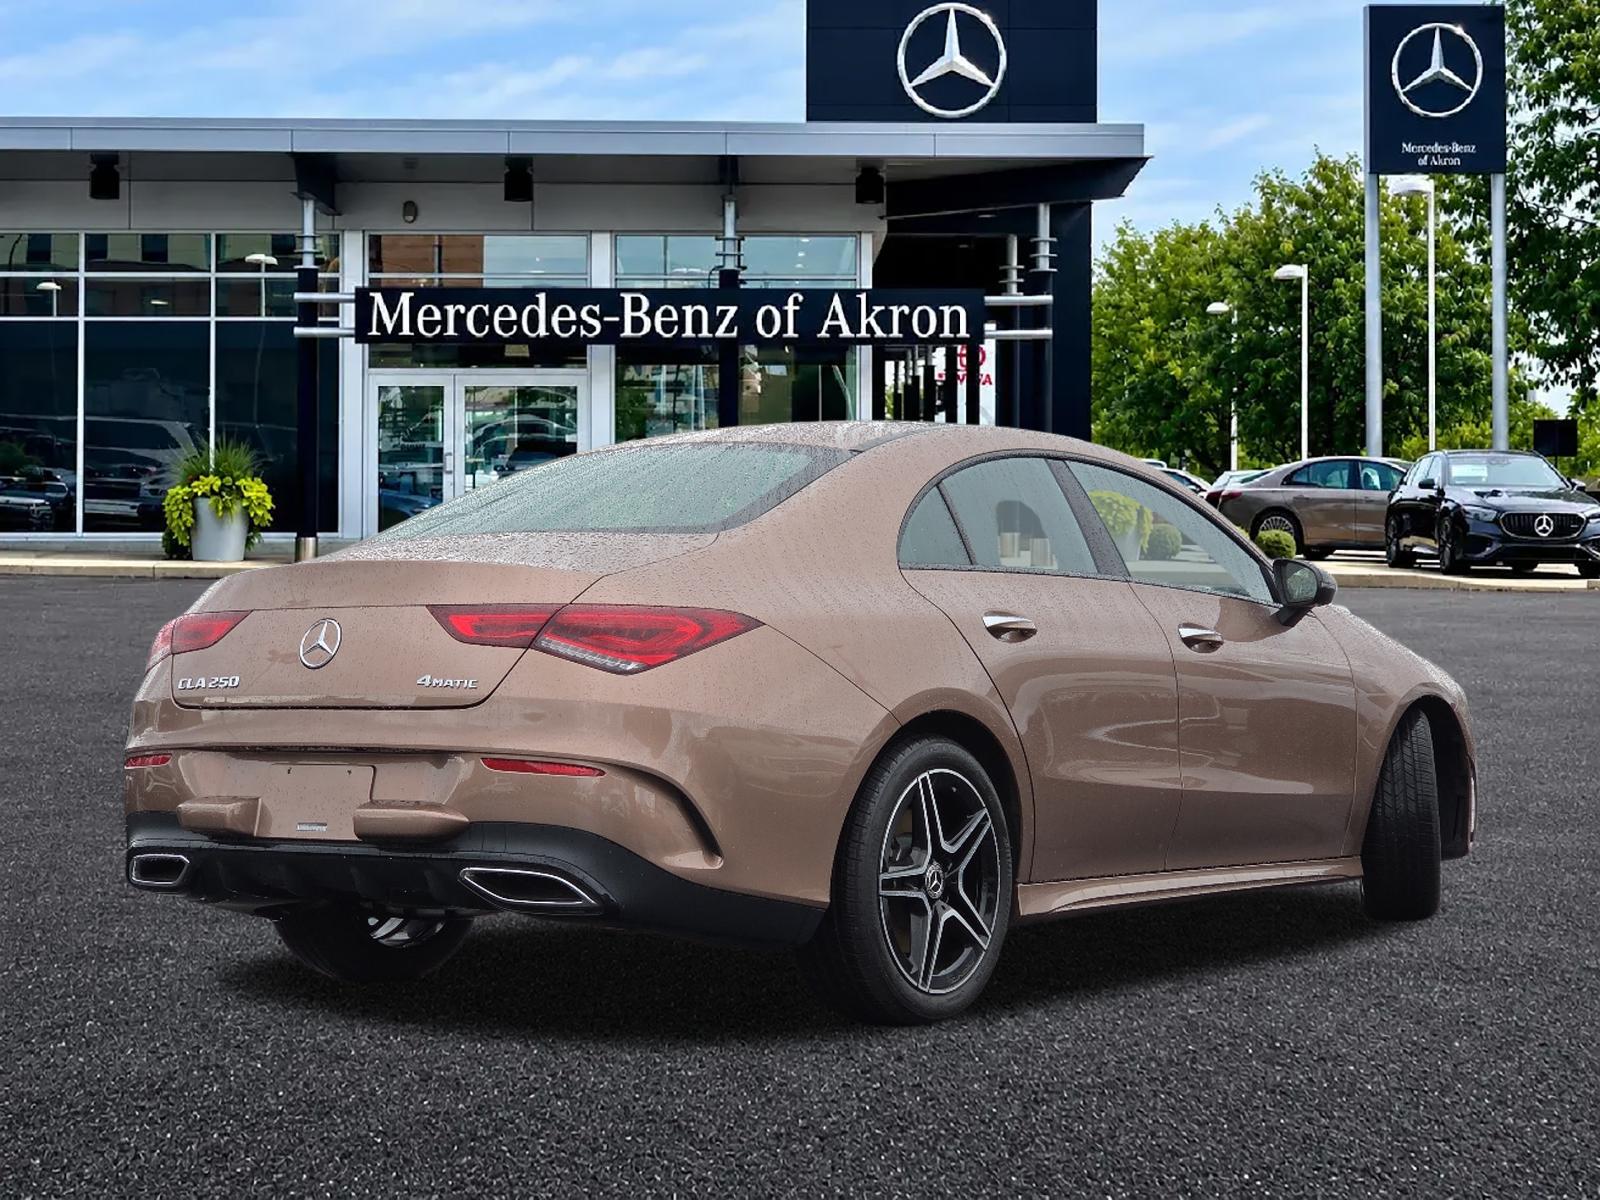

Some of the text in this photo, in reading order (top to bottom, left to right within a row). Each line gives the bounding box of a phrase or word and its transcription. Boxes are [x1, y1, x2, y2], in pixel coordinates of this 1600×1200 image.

[1418, 155, 1461, 166] of Akron
[367, 292, 970, 338] Mercedes-Benz of Akron
[178, 675, 240, 690] CLA 250
[416, 674, 478, 689] 4MATIC
